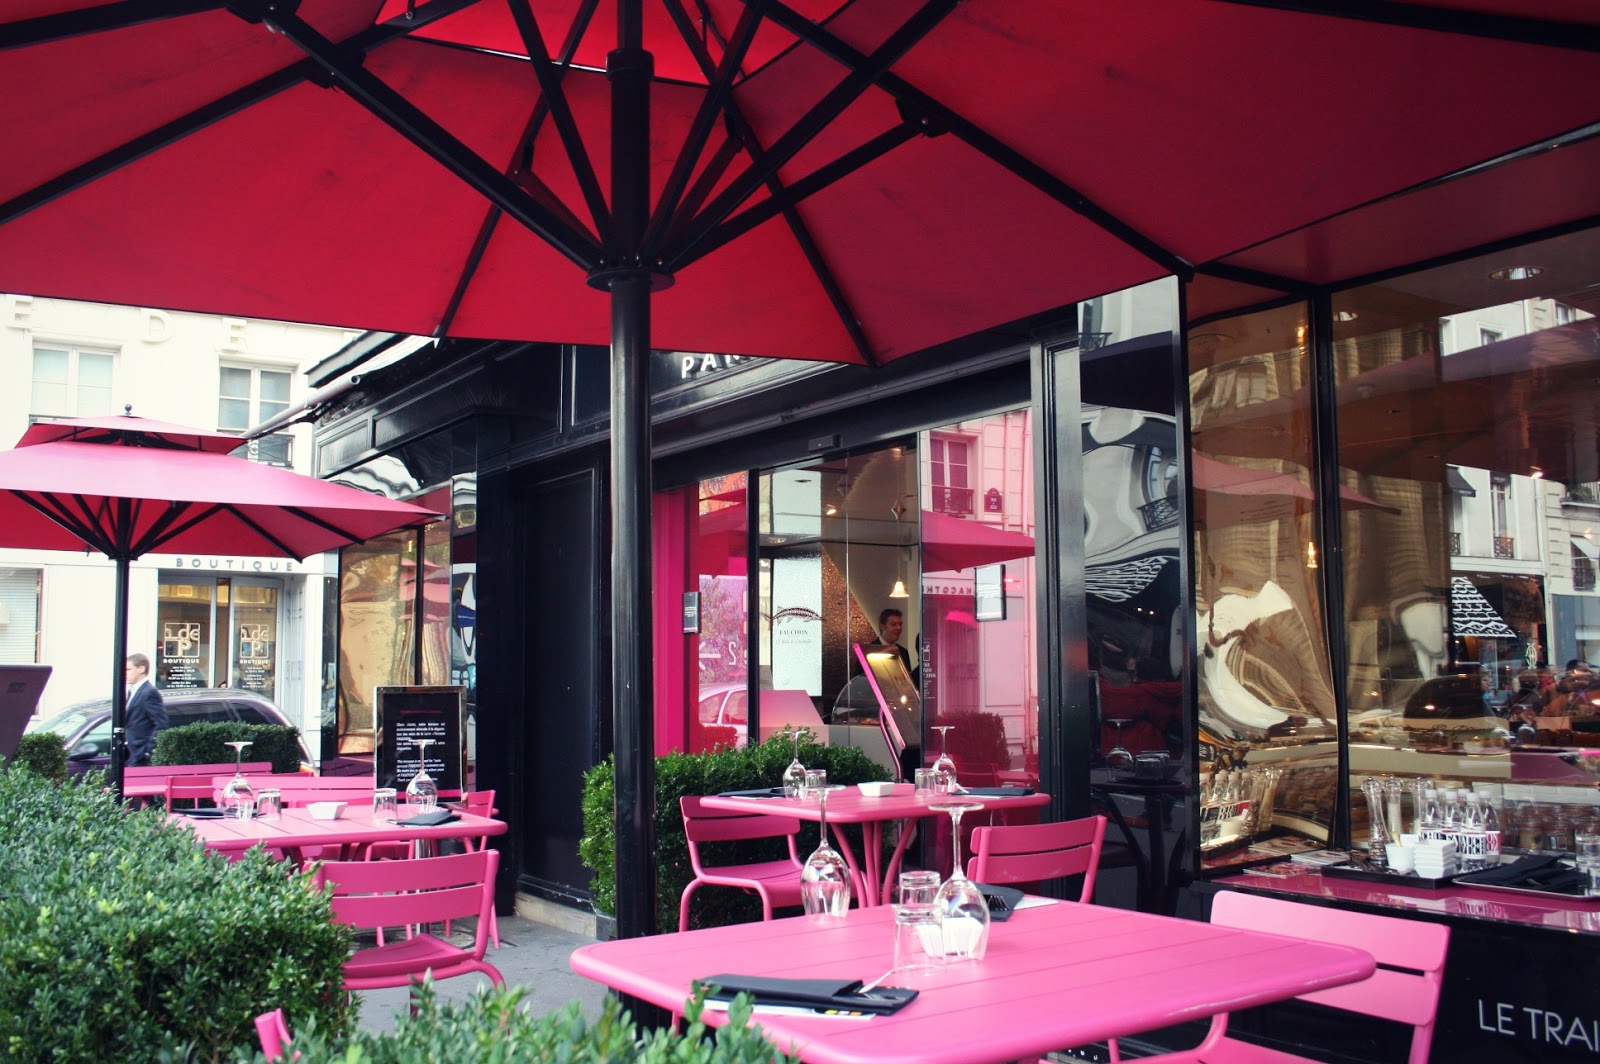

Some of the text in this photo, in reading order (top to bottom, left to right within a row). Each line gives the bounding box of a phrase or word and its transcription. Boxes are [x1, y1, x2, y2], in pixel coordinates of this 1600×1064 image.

[176, 558, 293, 571] BOUTIQUE
[1478, 999, 1599, 1052] LE TRAI
